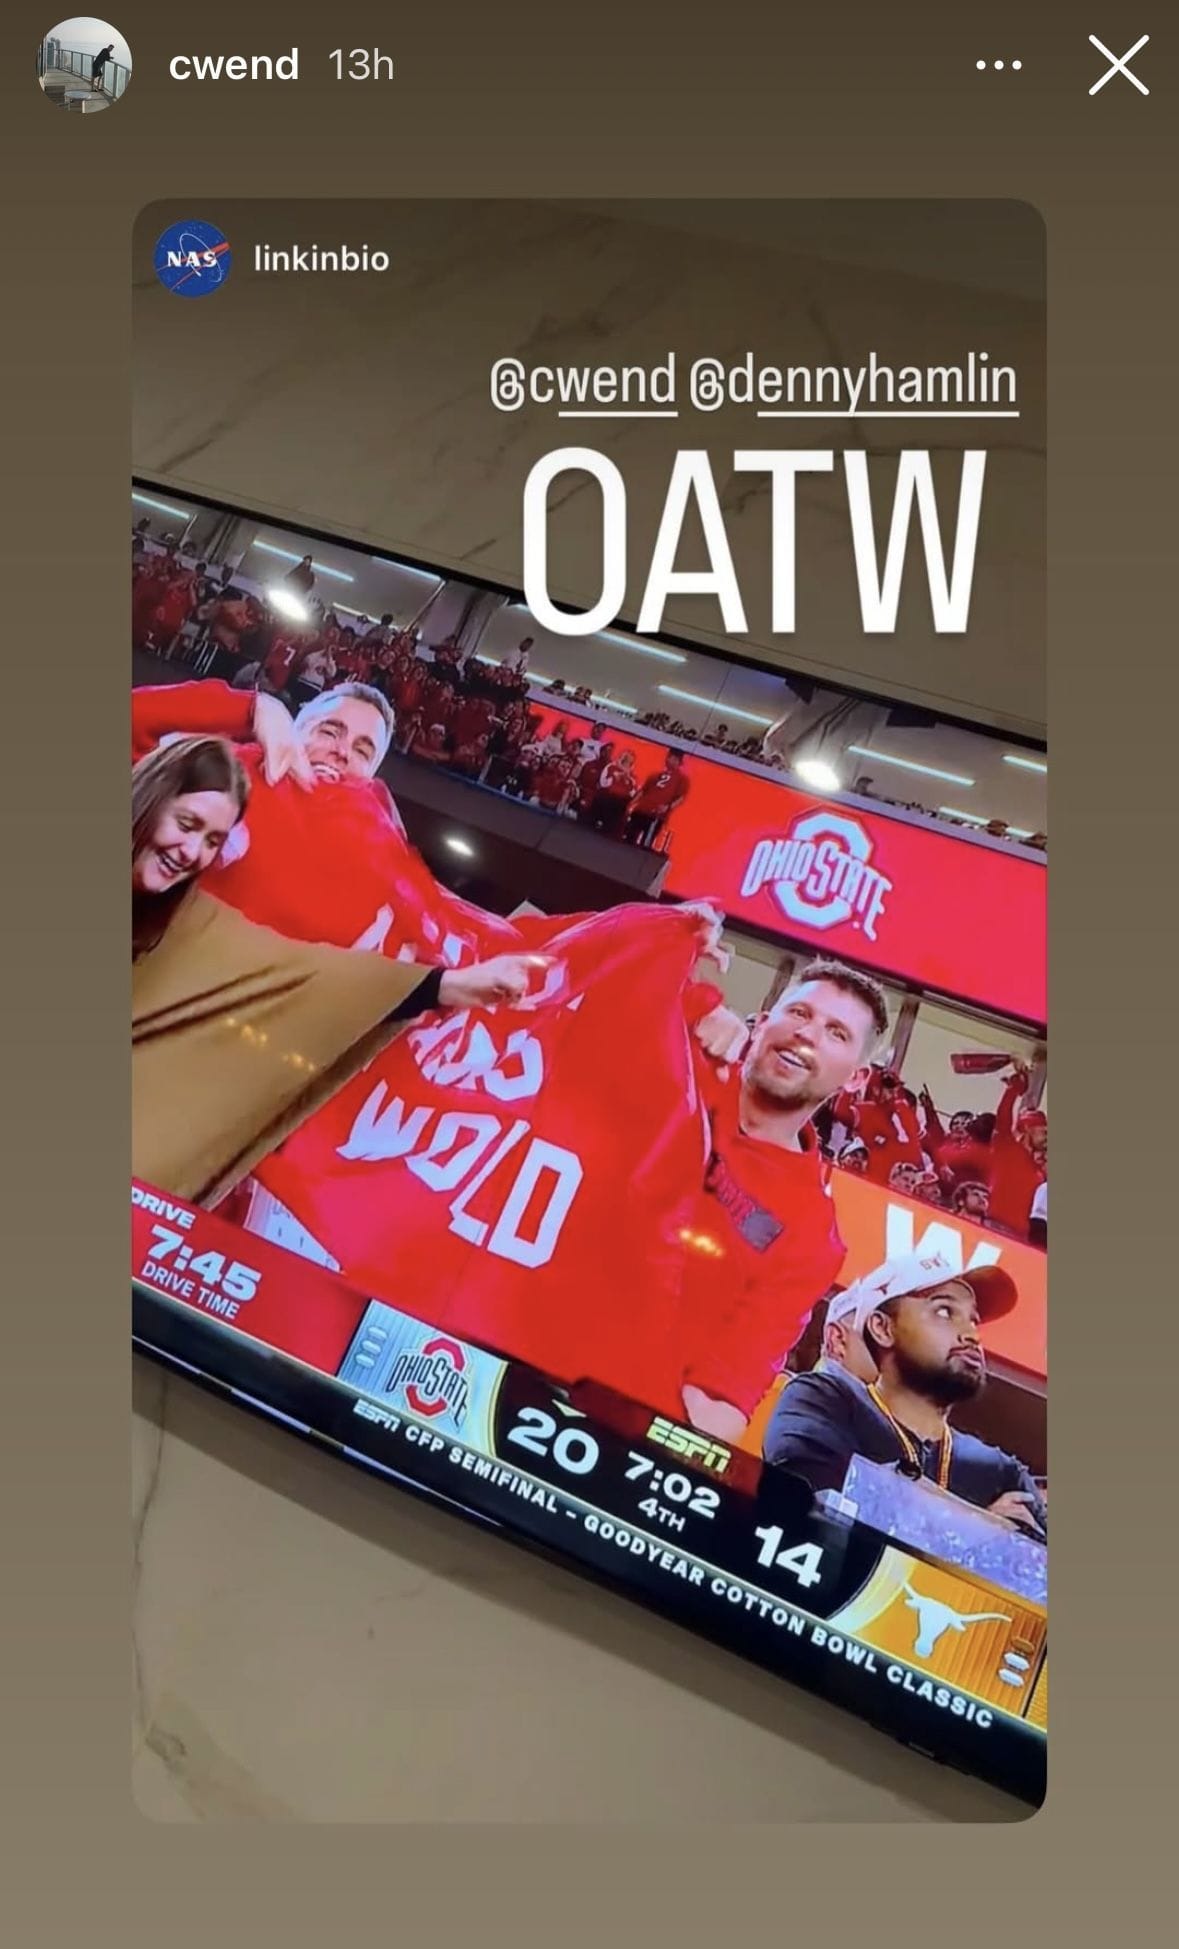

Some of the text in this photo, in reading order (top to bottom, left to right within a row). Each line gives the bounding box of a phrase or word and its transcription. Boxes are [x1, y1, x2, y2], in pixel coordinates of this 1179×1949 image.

[131, 1186, 196, 1230] DRIVE
[141, 1261, 240, 1320] DRIVE TIME
[148, 1224, 262, 1301] 7:45
[507, 1406, 599, 1475] 20
[646, 1416, 732, 1474] ESPN
[624, 1451, 721, 1520] 7:02
[638, 1497, 686, 1532] 4TH
[352, 1398, 401, 1433] ESPN
[405, 1425, 445, 1452] CFP
[449, 1447, 557, 1514] SEMIFINAL
[584, 1514, 705, 1586] GOODYEAR
[711, 1578, 806, 1636] COTTON
[810, 1627, 877, 1673] BOWL
[886, 1665, 994, 1728] CLASSIC
[755, 1525, 824, 1588] 14
